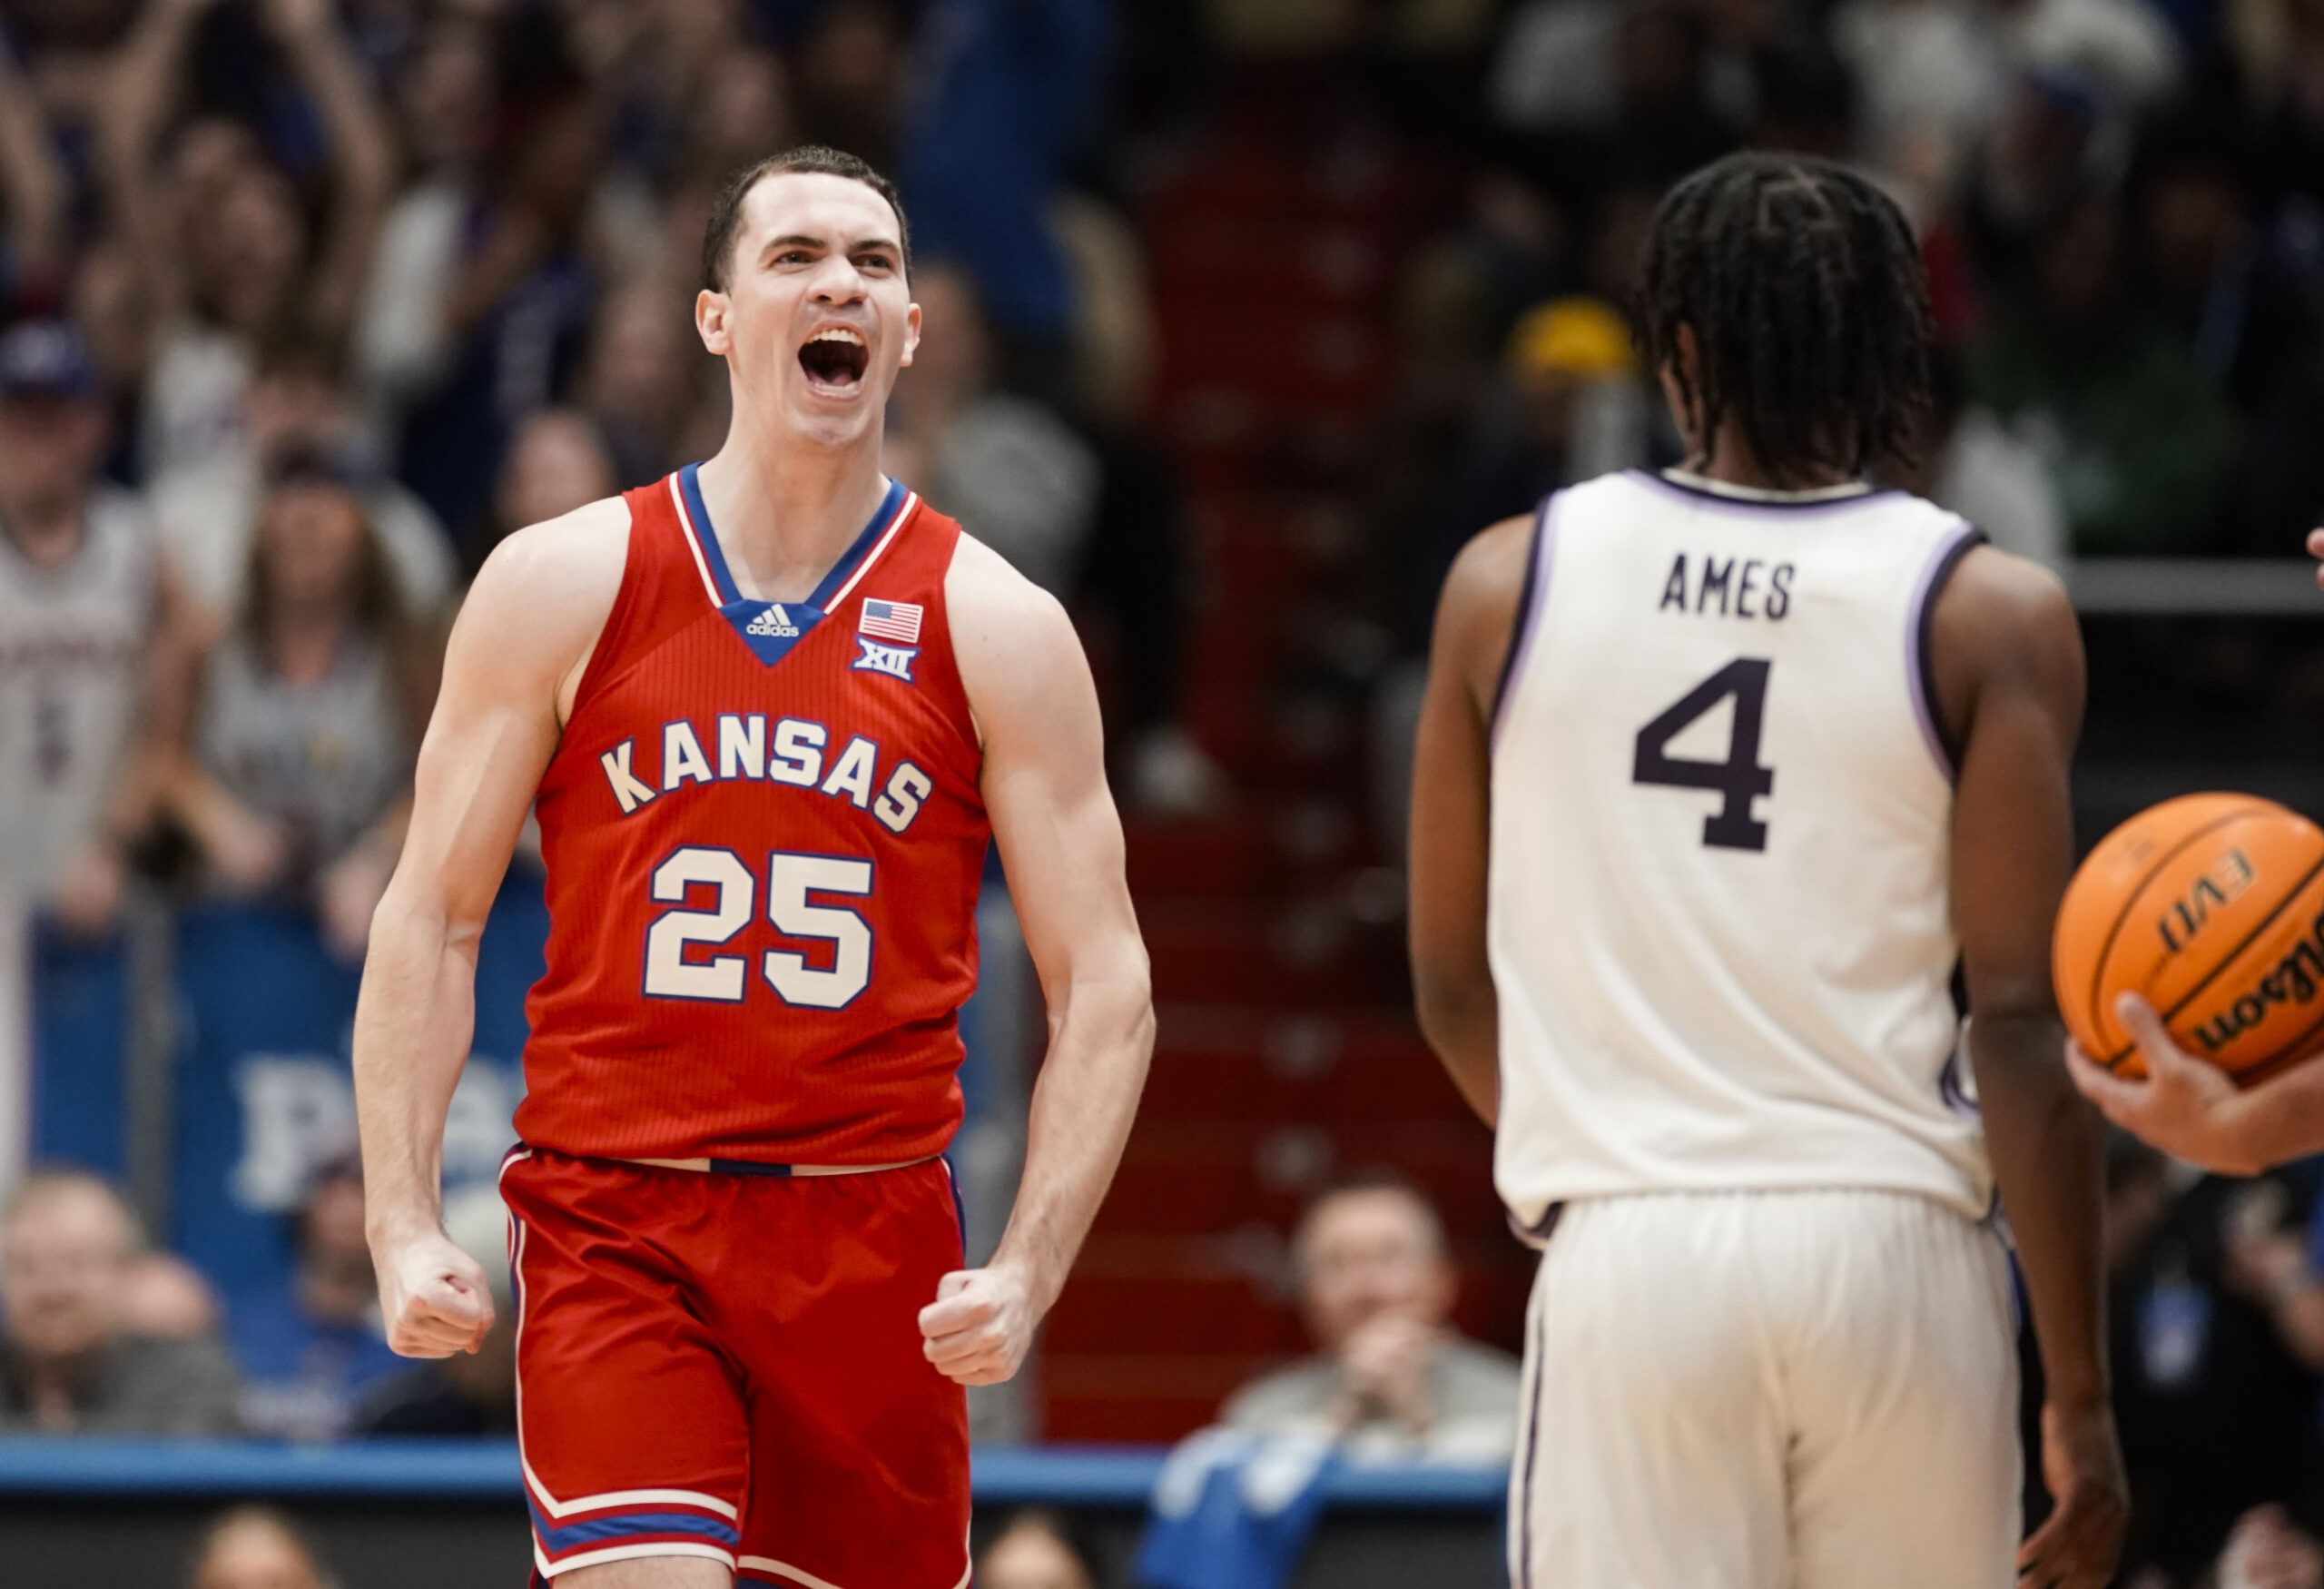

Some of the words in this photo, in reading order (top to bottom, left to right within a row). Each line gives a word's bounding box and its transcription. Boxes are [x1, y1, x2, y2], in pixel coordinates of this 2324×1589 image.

[746, 623, 800, 637] adidas
[1659, 553, 1795, 621] AMES
[852, 637, 918, 683] XII
[599, 714, 932, 834] KANSAS
[1632, 655, 1774, 853] 4
[642, 844, 874, 1012] 25
